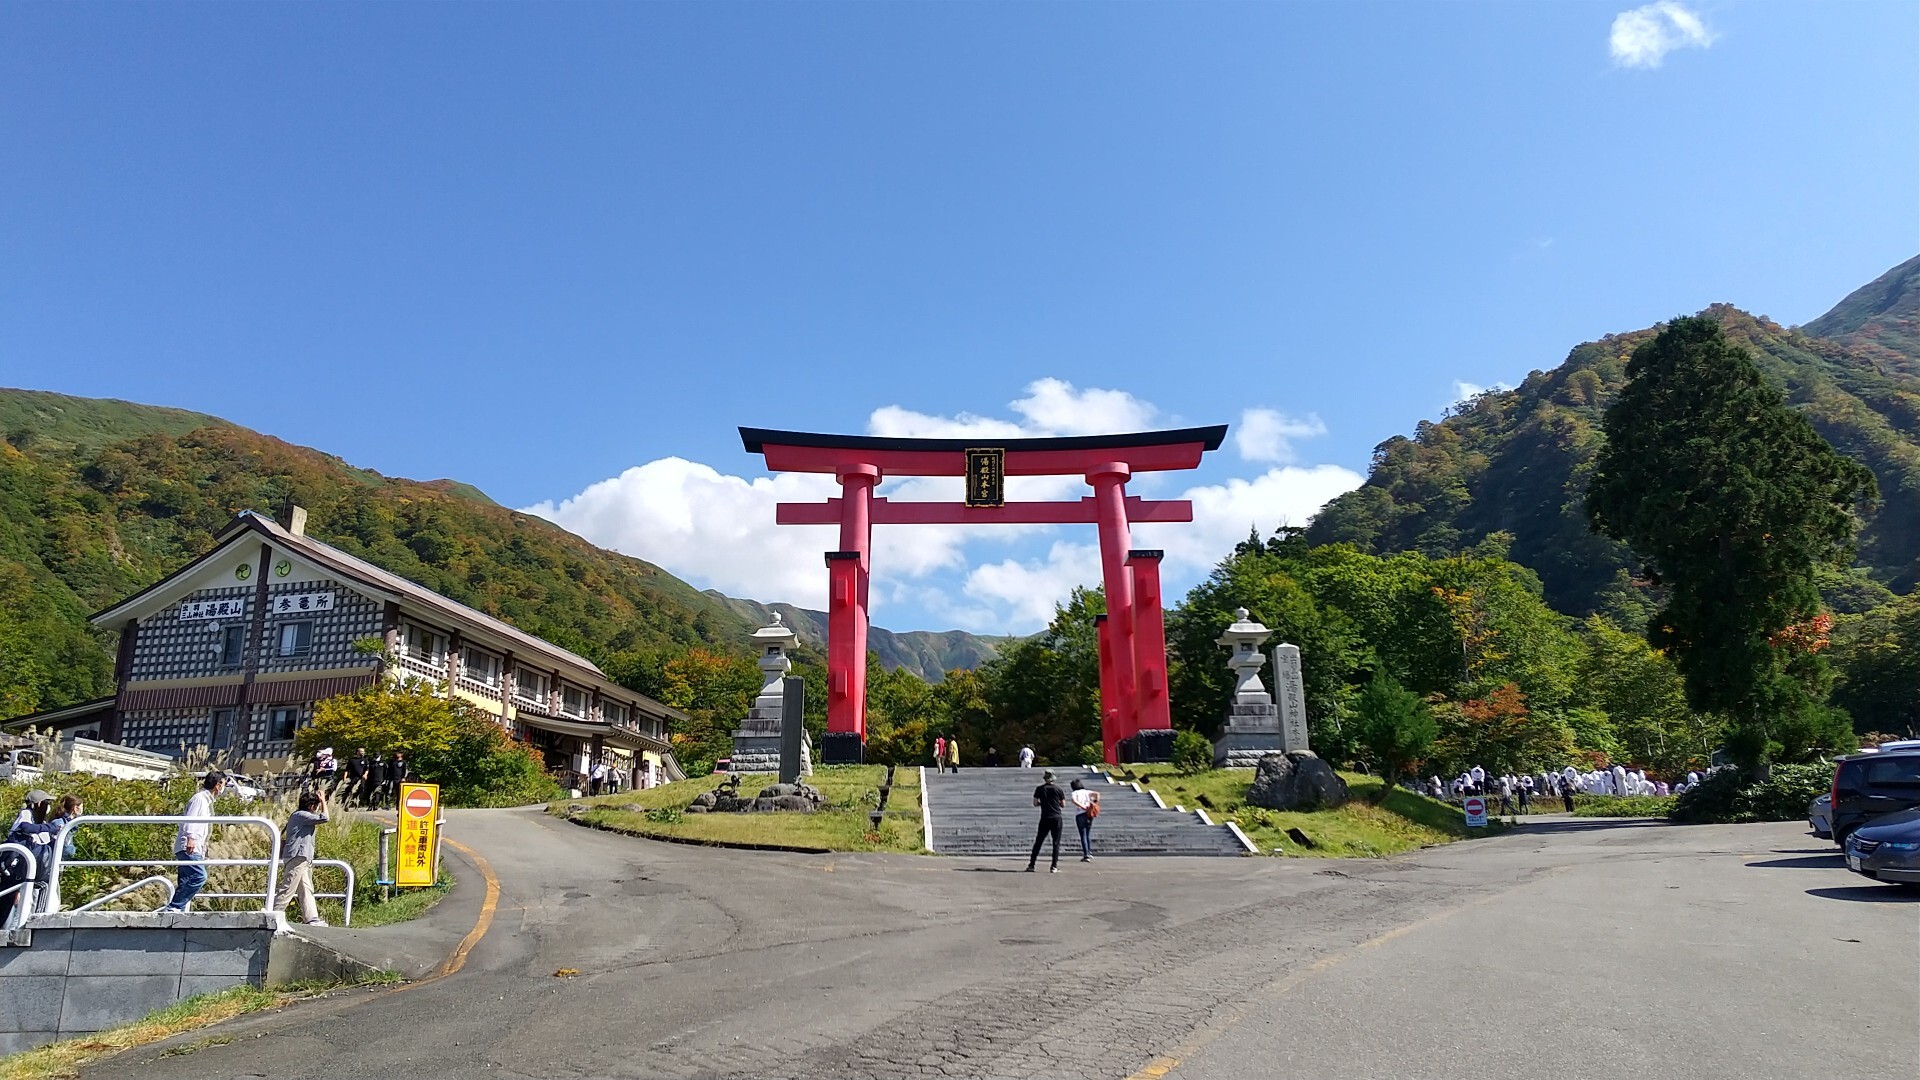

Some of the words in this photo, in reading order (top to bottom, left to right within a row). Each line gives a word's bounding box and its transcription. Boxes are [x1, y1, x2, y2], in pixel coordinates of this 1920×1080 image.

[979, 457, 991, 498] 湯殿山本宮
[205, 603, 242, 616] 湯殿山
[404, 820, 418, 867] 進入禁止
[416, 820, 428, 867] 許可車両以外
